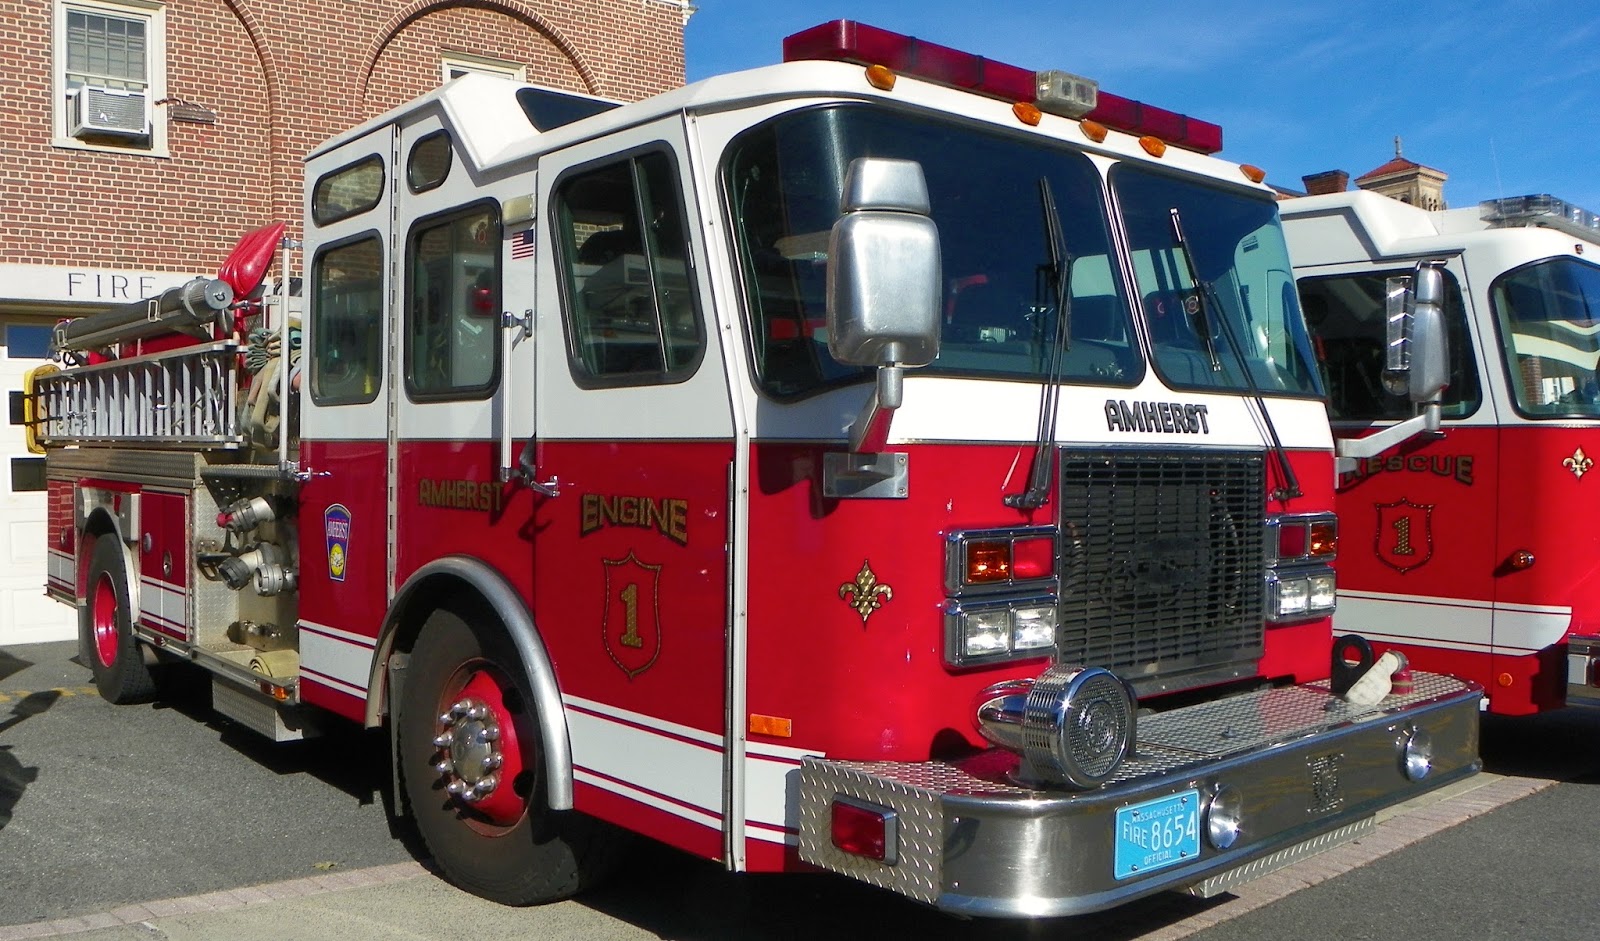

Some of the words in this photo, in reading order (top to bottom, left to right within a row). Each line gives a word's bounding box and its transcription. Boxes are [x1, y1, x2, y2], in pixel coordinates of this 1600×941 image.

[68, 272, 156, 299] FIRE
[1104, 399, 1209, 434] AMHERST
[418, 477, 504, 513] AMHERST
[580, 494, 688, 547] ENGINE
[1392, 516, 1415, 555] 1
[620, 583, 643, 648] 1
[1123, 820, 1149, 849] FIRE
[1151, 810, 1196, 852] 8654
[1131, 803, 1185, 823] MASSACHUSETTS
[1143, 850, 1172, 865] OFFICIAL
